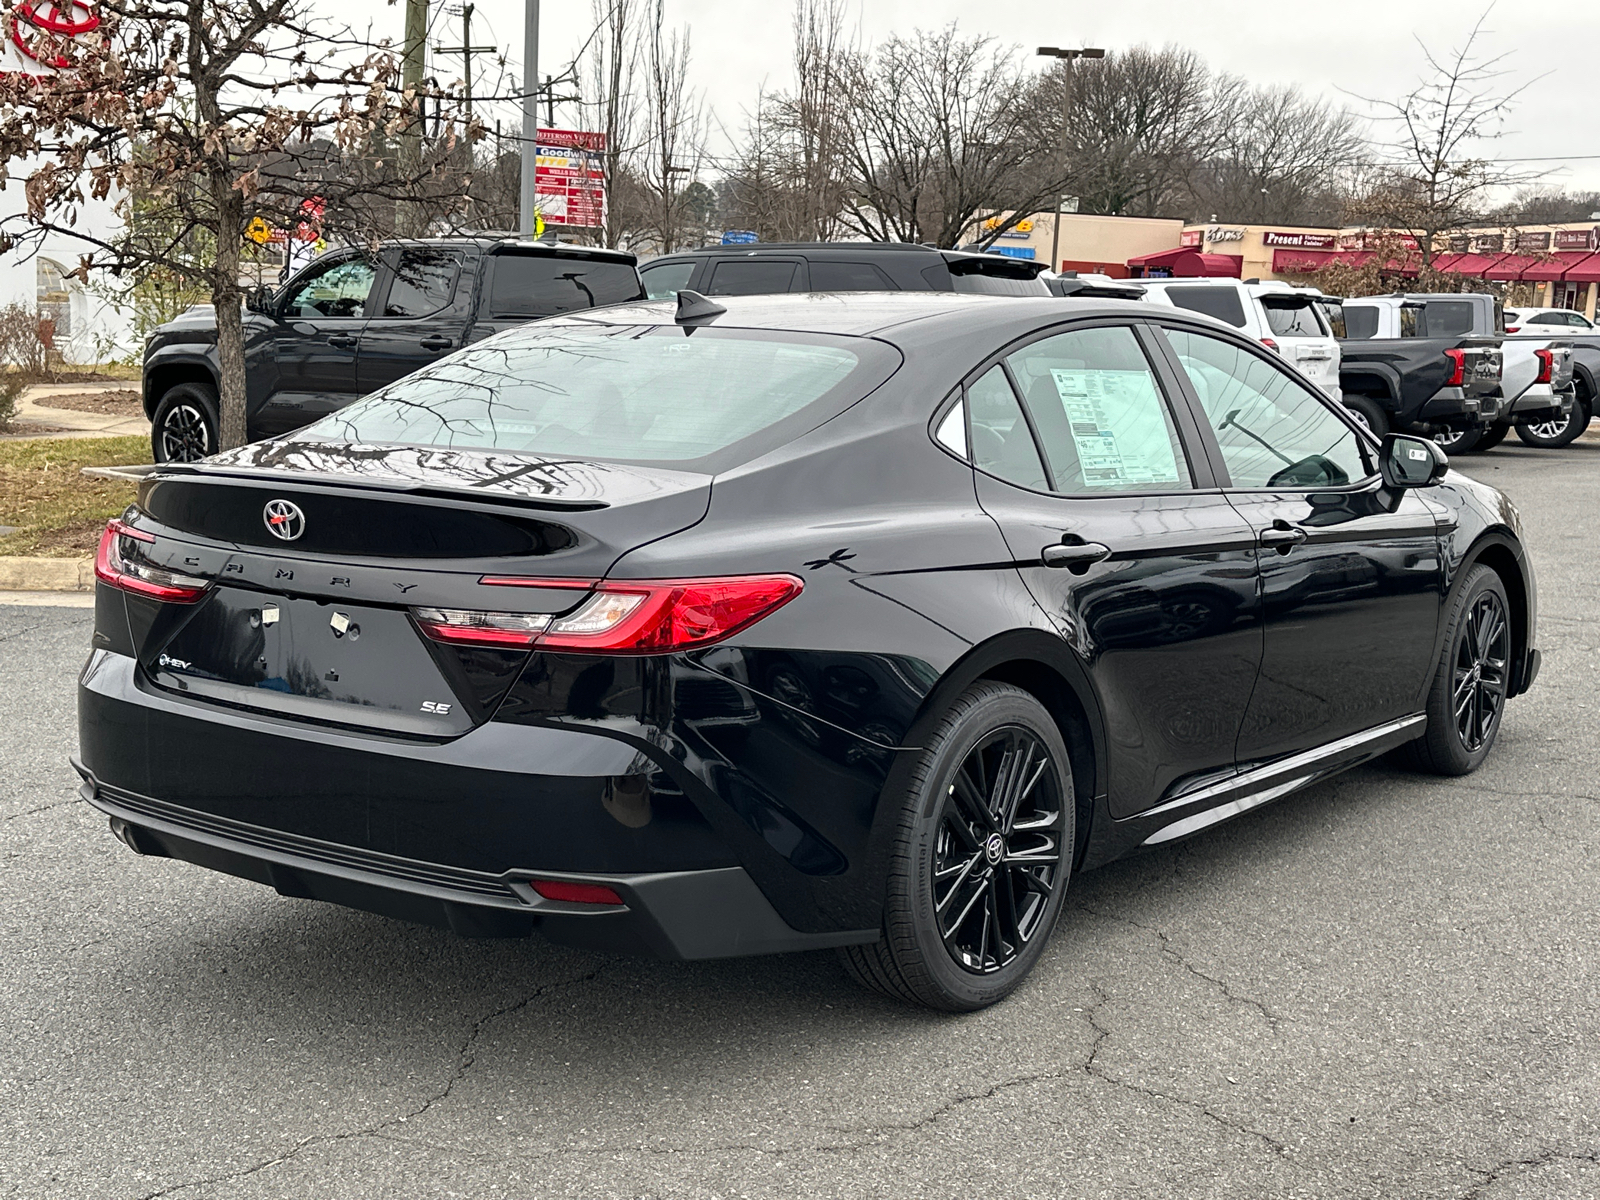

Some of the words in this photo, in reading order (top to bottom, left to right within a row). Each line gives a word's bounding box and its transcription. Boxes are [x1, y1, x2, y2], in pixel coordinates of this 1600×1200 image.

[541, 148, 589, 159] Goodw
[548, 168, 569, 176] WELLS
[1267, 233, 1303, 245] Present
[183, 557, 418, 593] CAMRY
[420, 700, 452, 715] SE
